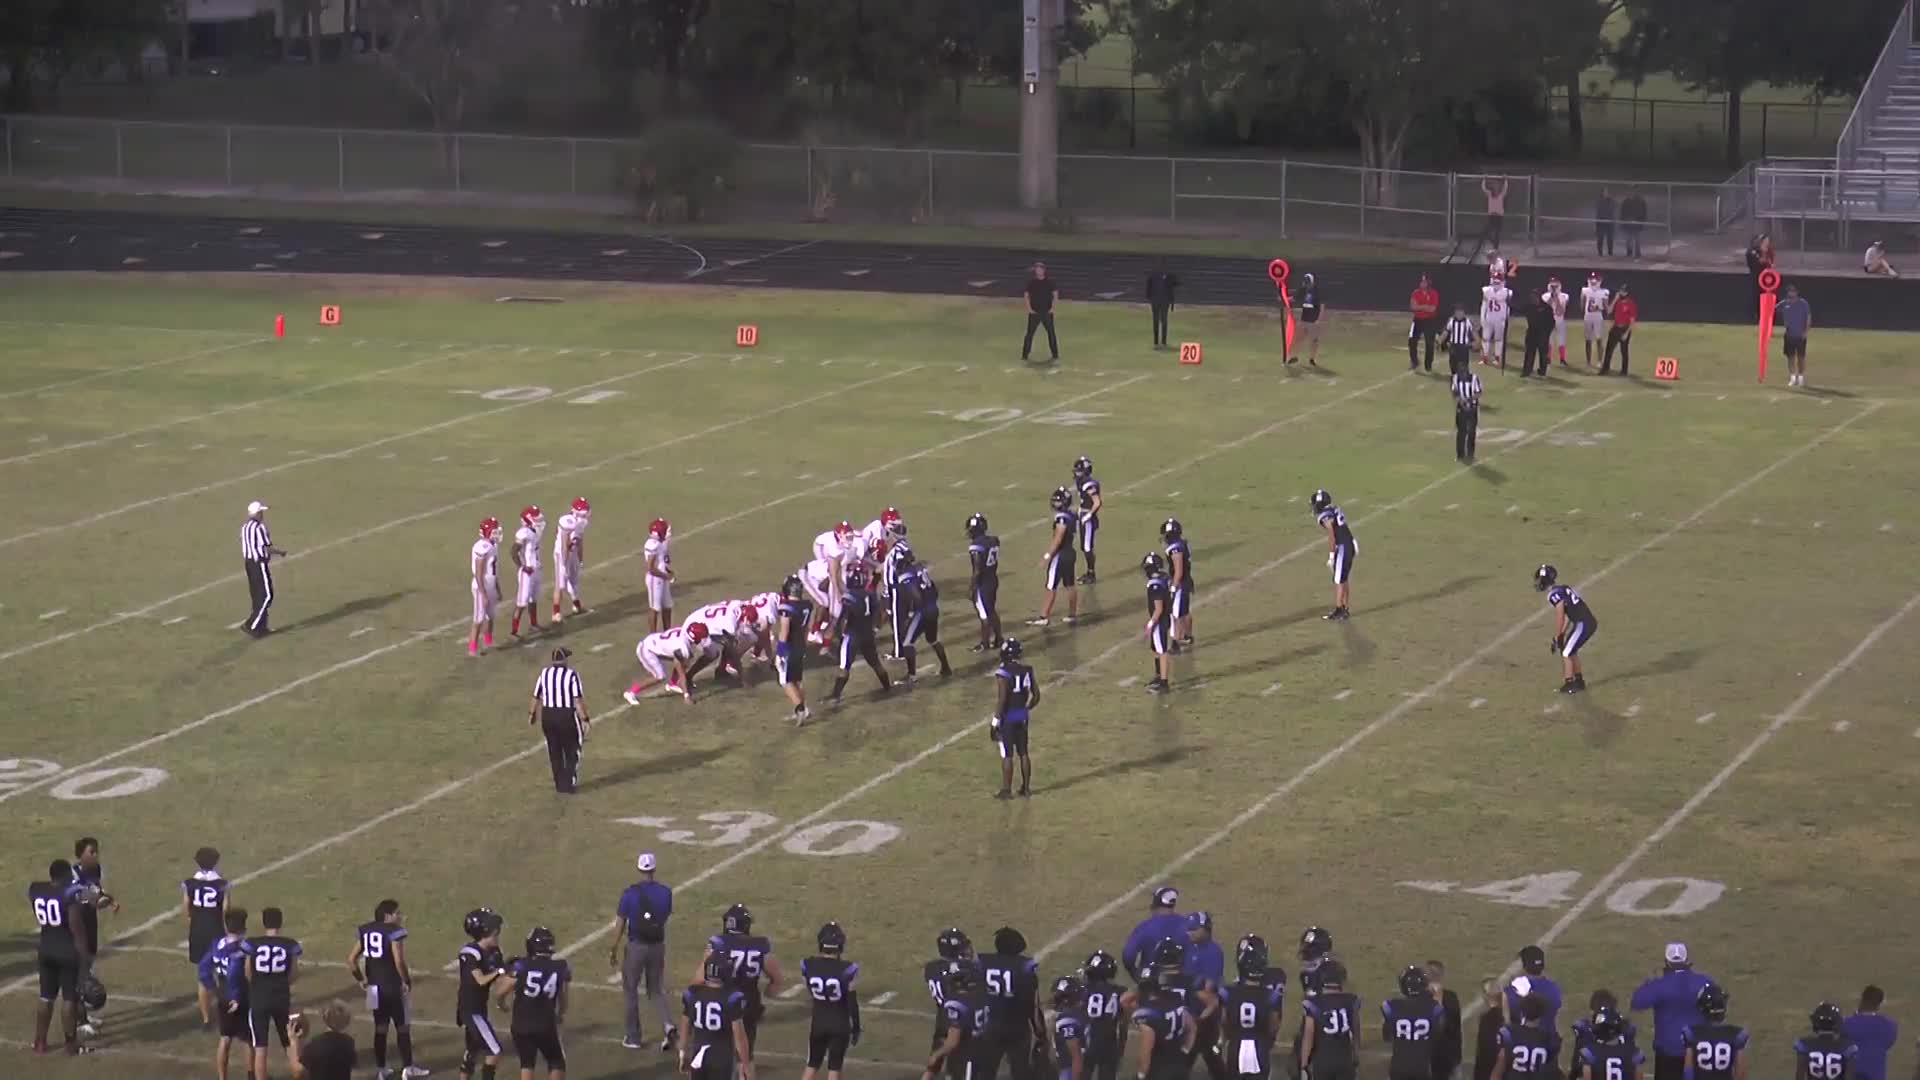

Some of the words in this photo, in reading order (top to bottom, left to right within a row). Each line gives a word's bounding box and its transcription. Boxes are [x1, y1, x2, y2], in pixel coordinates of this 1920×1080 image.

[326, 308, 335, 321] G
[740, 327, 753, 342] 10
[1183, 345, 1197, 361] 20
[1658, 360, 1674, 375] 30
[801, 607, 810, 627] 7
[864, 596, 871, 617] 1
[1013, 672, 1031, 692] 14
[656, 811, 902, 856] 30
[193, 888, 218, 908] 12
[1460, 870, 1727, 915] 40
[34, 898, 61, 926] 60
[363, 932, 384, 958] 19
[255, 945, 288, 973] 22
[730, 950, 762, 977] 75
[524, 971, 558, 999] 54
[809, 977, 841, 1000] 23
[985, 969, 1014, 998] 51
[693, 1001, 722, 1030] 16
[1087, 993, 1119, 1018] 84
[1239, 1002, 1256, 1028] 8
[1323, 1008, 1350, 1034] 31
[1512, 1045, 1547, 1072] 20
[1606, 1057, 1622, 1080] 6
[1696, 1041, 1731, 1070] 28
[1809, 1051, 1842, 1079] 26
